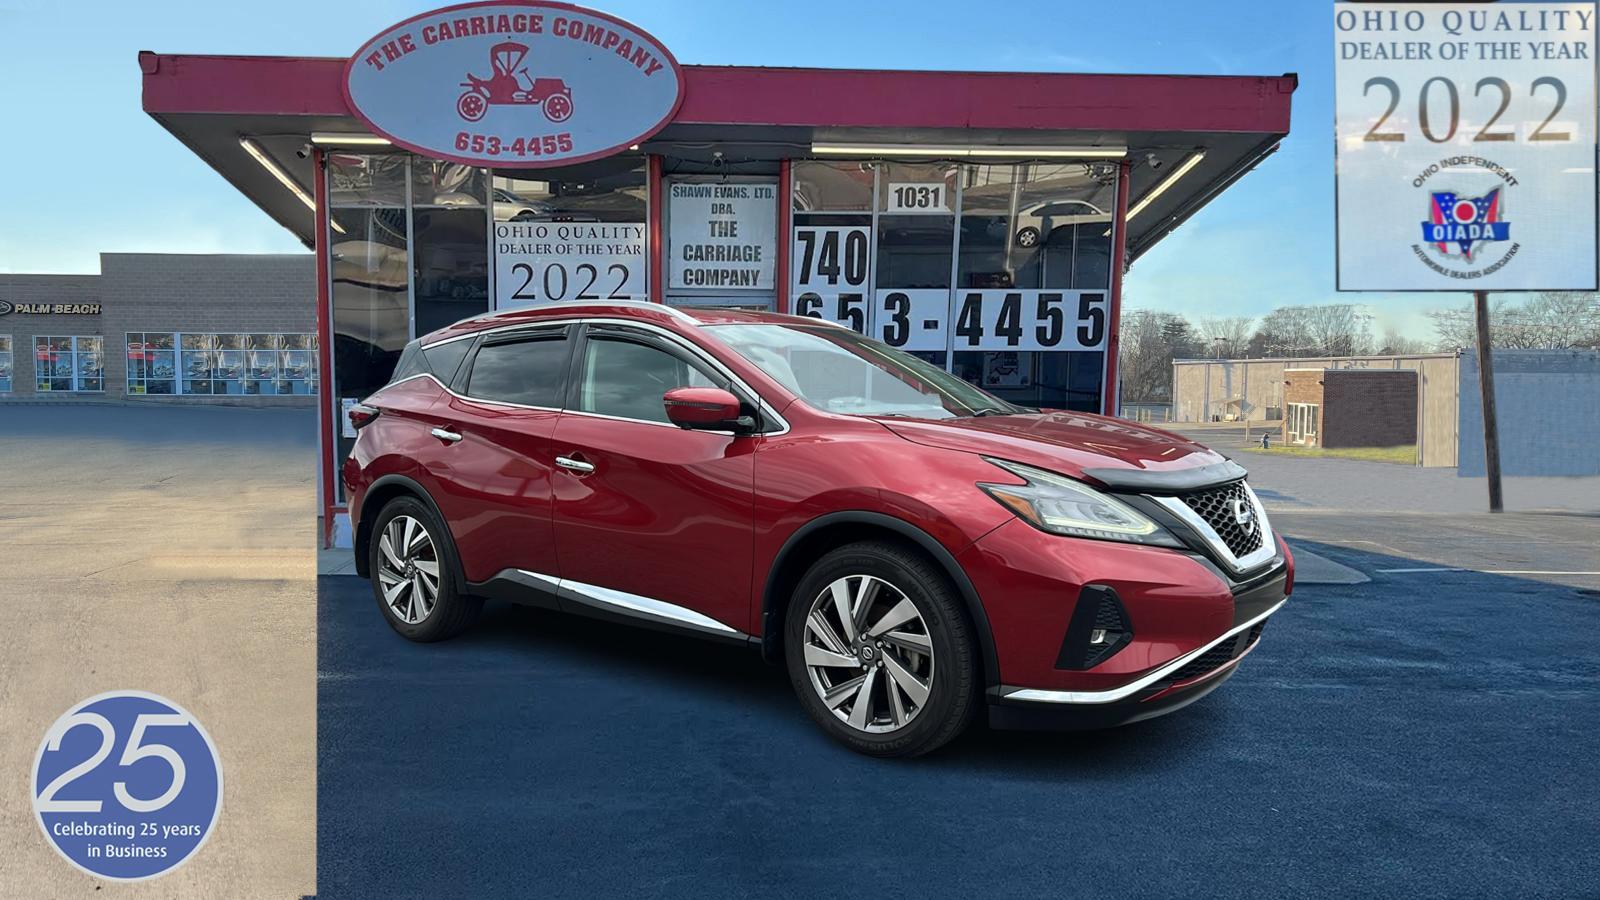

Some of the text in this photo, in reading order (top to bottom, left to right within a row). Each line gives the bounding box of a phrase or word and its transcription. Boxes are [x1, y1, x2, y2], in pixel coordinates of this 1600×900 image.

[1337, 10, 1592, 36] OHIO QUALITY
[366, 14, 664, 77] THE CARRIAGE COMPANY
[1340, 42, 1589, 60] DEALER OF THE YEAR
[1363, 76, 1571, 143] 2022
[455, 132, 573, 157] 653-4455
[1413, 156, 1519, 188] OHIO INDEPENDENT
[673, 186, 711, 198] SHAWN
[754, 187, 775, 199] LTD.
[894, 186, 940, 208] 1031
[711, 203, 736, 215] DBA.
[497, 226, 644, 240] OHIO QUALITY
[708, 220, 738, 238] THE
[1432, 224, 1495, 240] OIADA
[500, 244, 641, 255] DEALER OF THE YEAR
[683, 244, 762, 262] CARRIAGE
[797, 230, 867, 285] 740
[1411, 242, 1520, 280] AUTOMOBILE DEALERS ASSOCIATION
[511, 263, 631, 300] 2022
[683, 268, 761, 286] COMPANY
[15, 304, 101, 314] PALM BEACH
